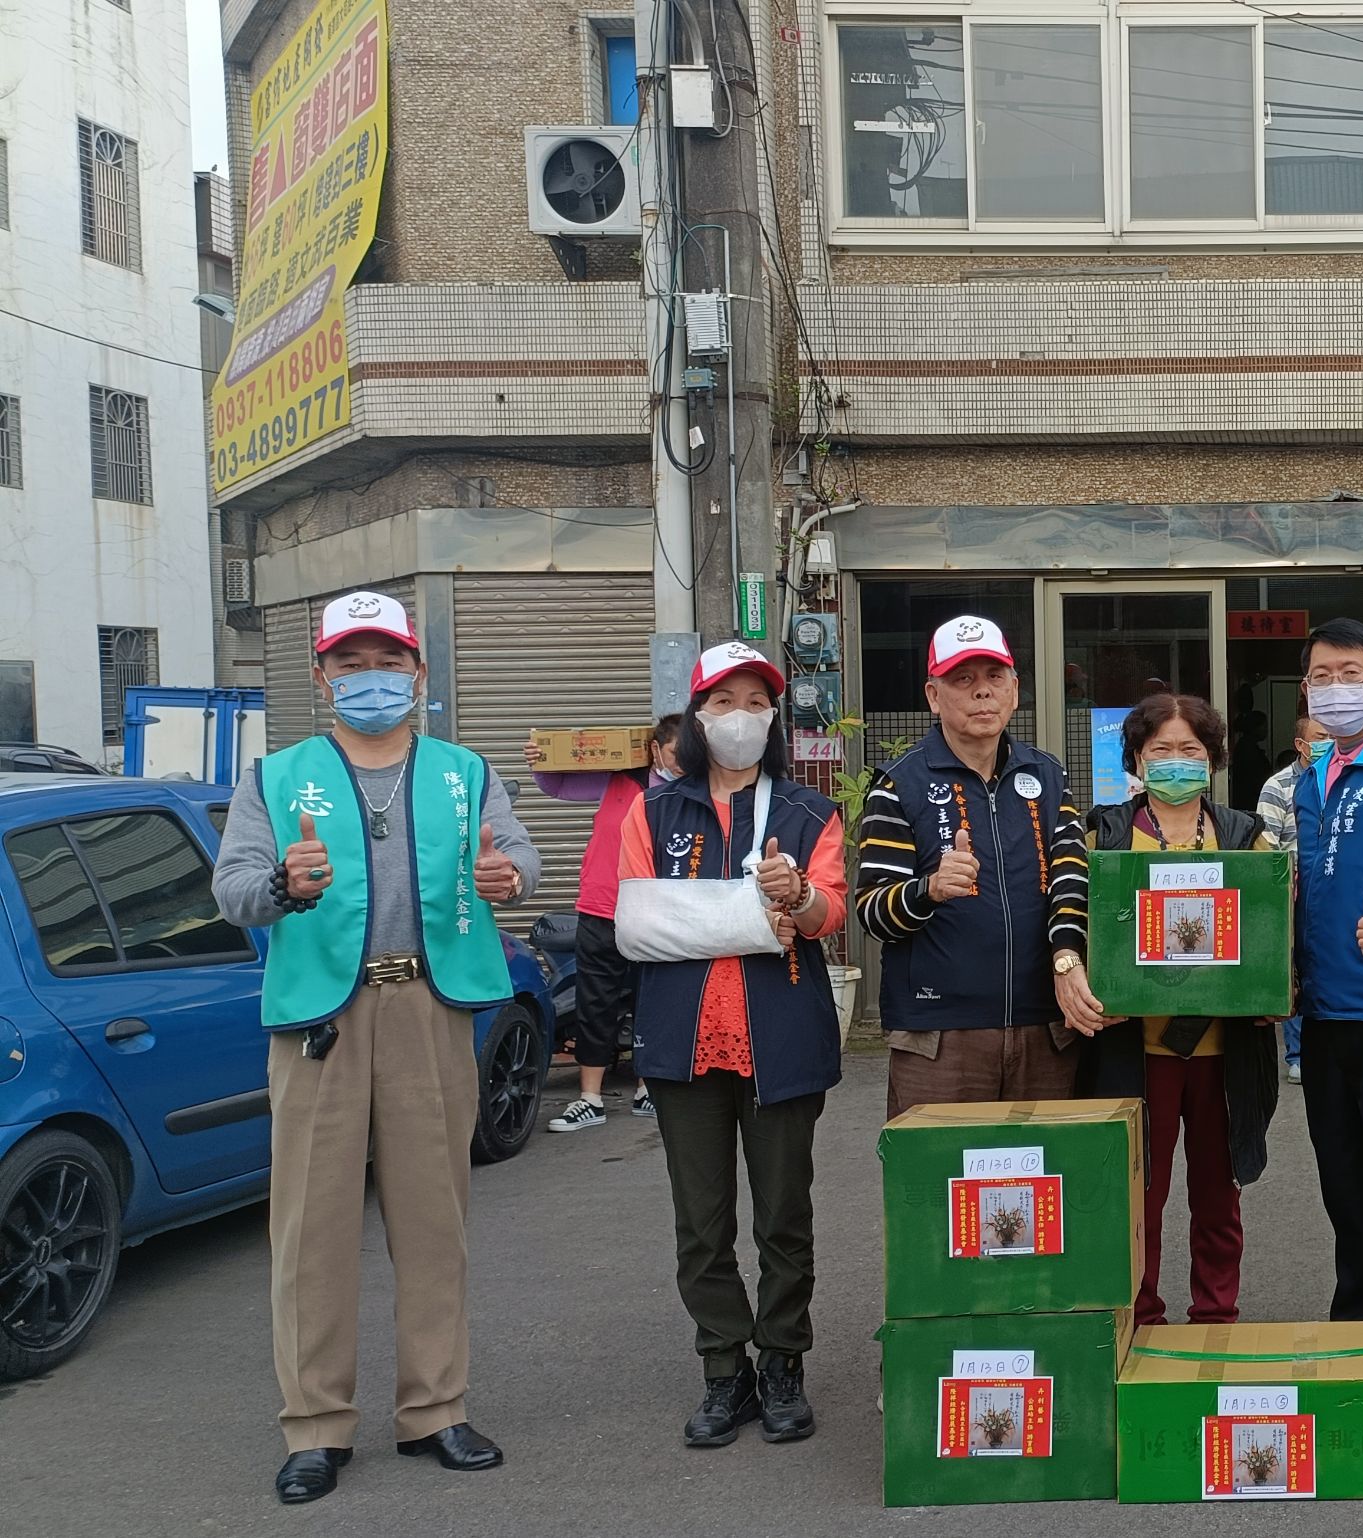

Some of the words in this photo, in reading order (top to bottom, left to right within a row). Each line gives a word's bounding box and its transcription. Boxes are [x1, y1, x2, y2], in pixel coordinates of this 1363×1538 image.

[216, 319, 343, 439] 0937-118806
[217, 374, 345, 483] 03-4899777
[749, 583, 760, 630] 0311032
[807, 742, 832, 758] 44
[288, 781, 334, 817] 志
